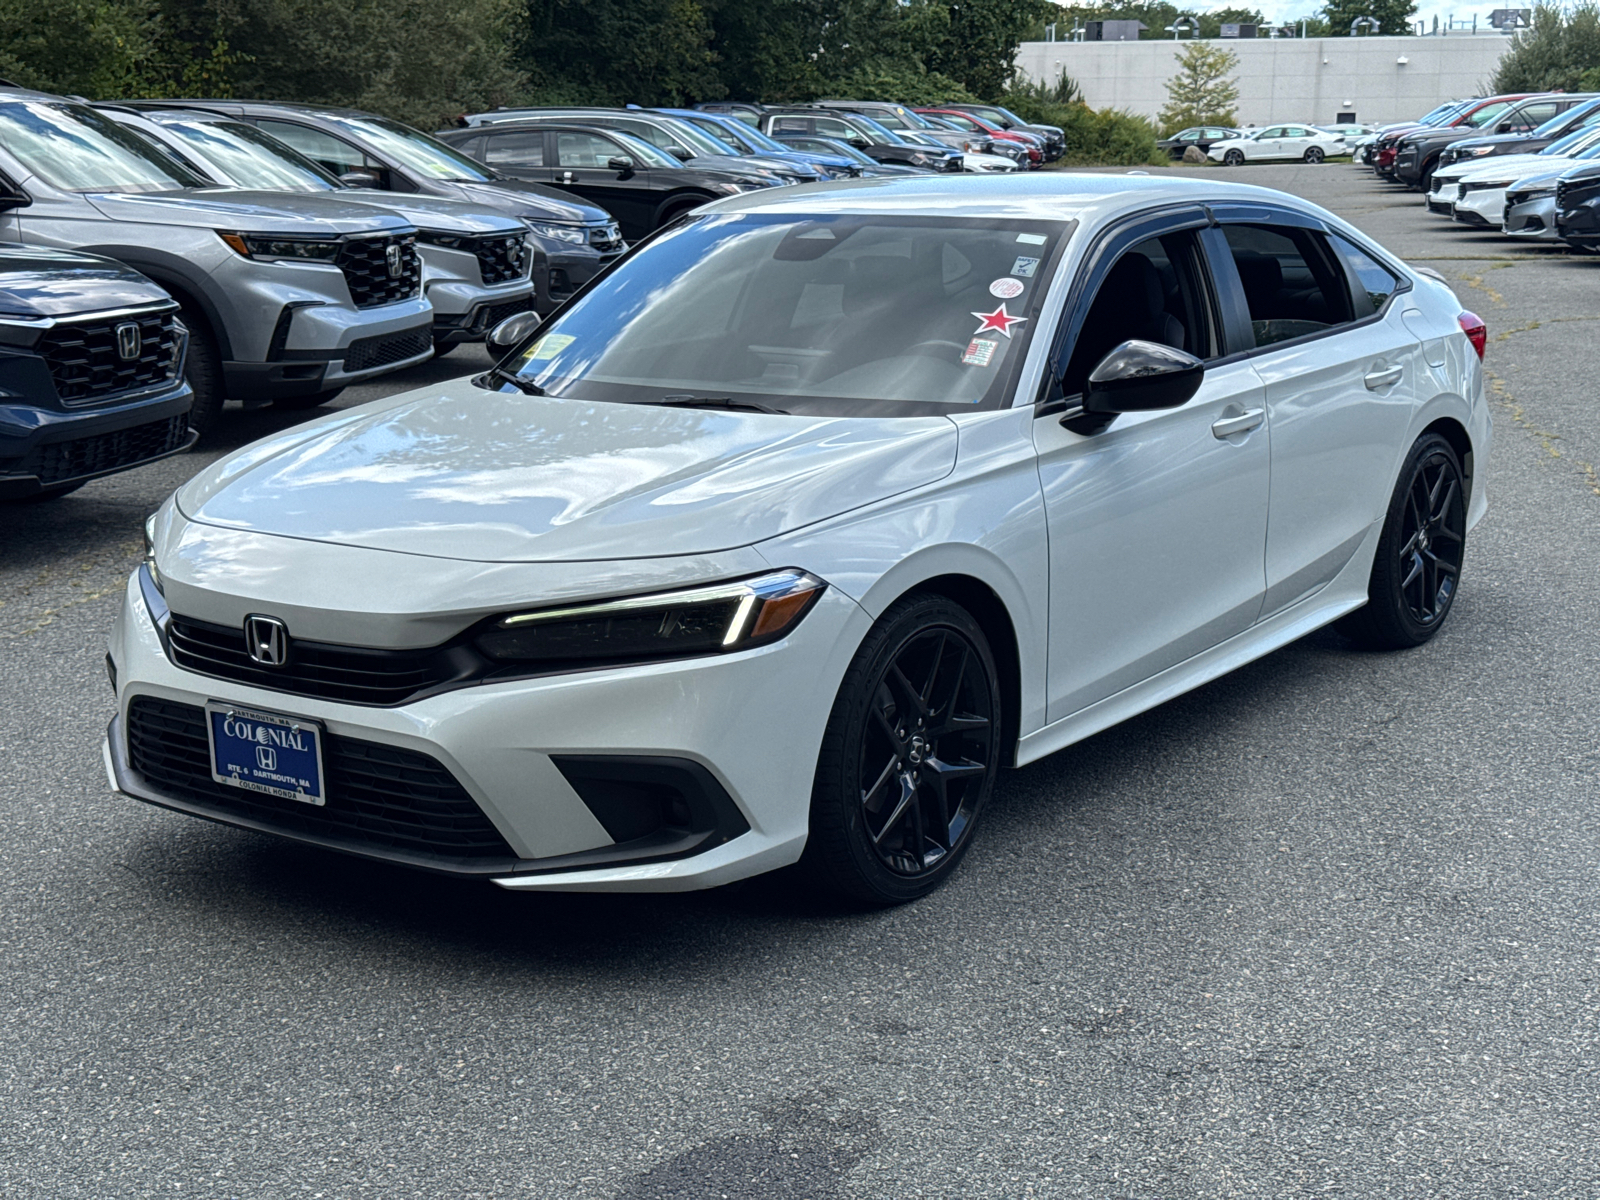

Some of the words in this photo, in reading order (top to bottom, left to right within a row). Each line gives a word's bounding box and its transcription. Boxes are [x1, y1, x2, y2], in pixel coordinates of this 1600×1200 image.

[223, 718, 308, 752] COLONIAL
[243, 767, 249, 775] 6
[253, 769, 298, 786] DARTMOUTH,
[298, 779, 311, 788] MA
[239, 781, 271, 794] COLONIAL
[272, 787, 297, 800] HONDA
